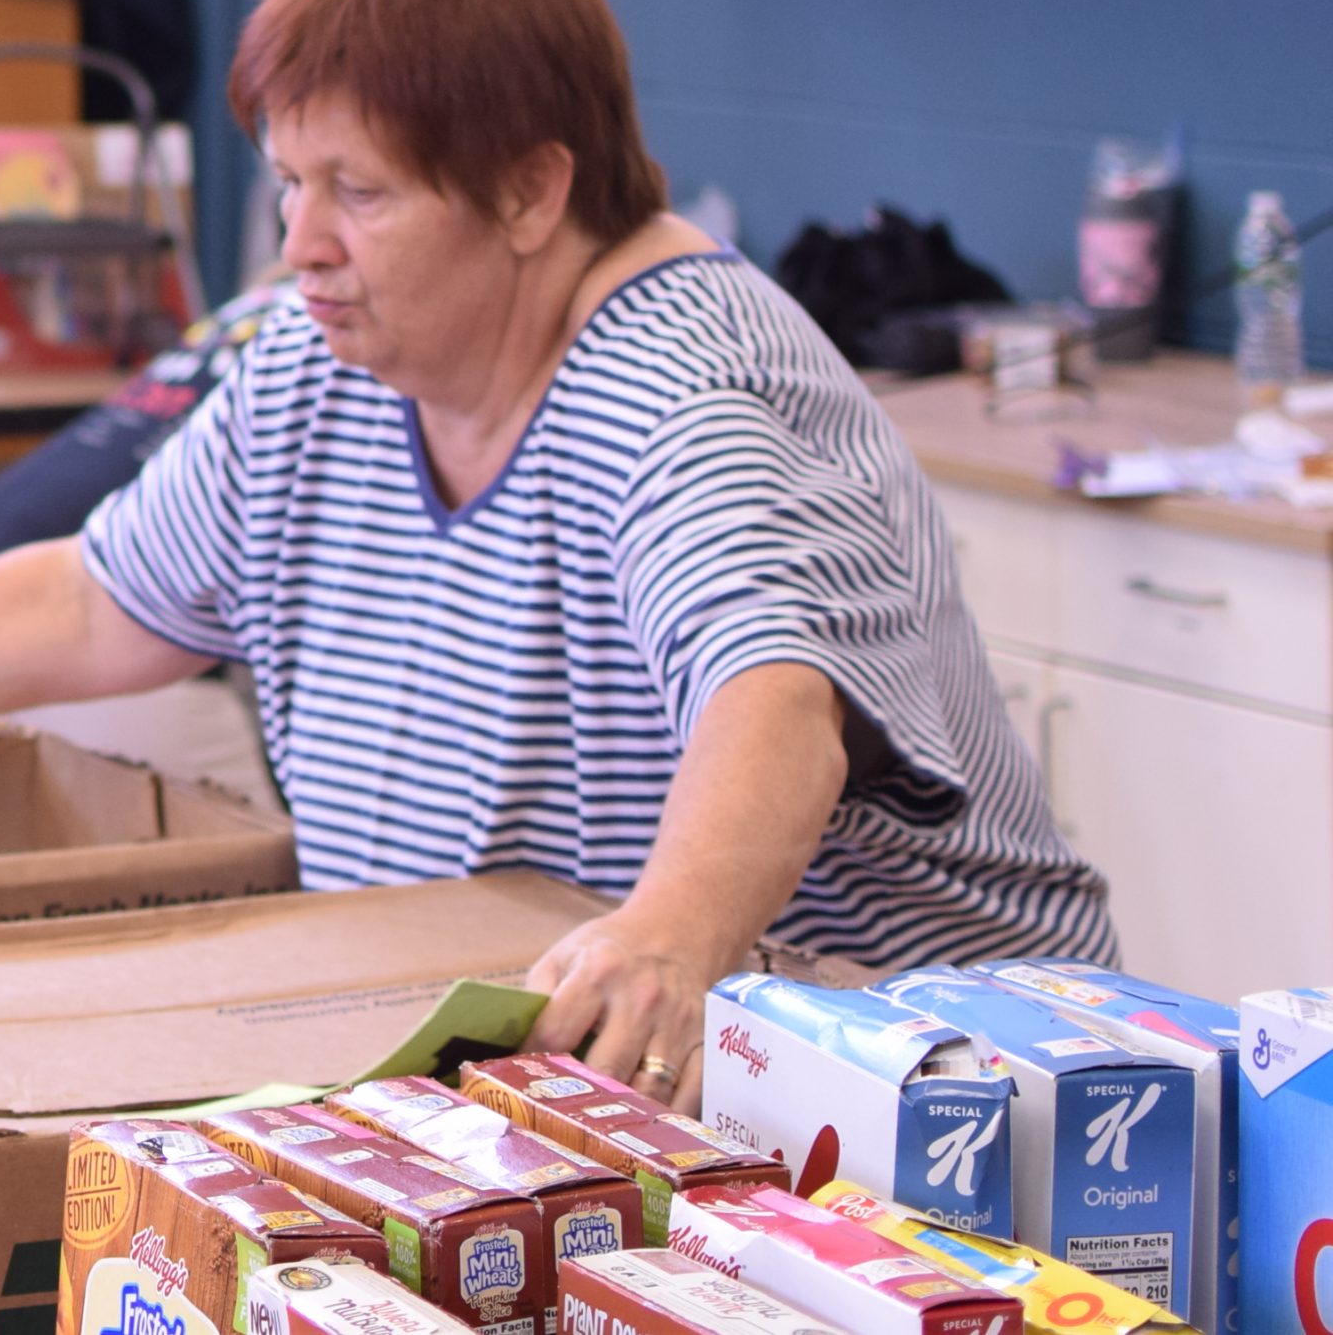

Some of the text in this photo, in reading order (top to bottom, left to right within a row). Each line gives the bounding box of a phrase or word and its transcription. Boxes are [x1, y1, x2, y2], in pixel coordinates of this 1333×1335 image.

[719, 1022, 771, 1078] Kellogg's
[1086, 1084, 1136, 1096] SPECIAL
[928, 1104, 983, 1118] SPECIAL
[716, 1112, 761, 1152] SPECIAL
[1085, 1082, 1162, 1172] K
[926, 1108, 1004, 1197] K
[66, 1151, 117, 1192] LIMITED
[830, 1194, 884, 1219] Post
[1084, 1184, 1159, 1211] Original
[66, 1194, 117, 1232] EDITION!
[570, 1216, 605, 1232] Frosted
[925, 1204, 993, 1233] Original
[475, 1237, 509, 1255] Frosted
[564, 1224, 614, 1254] Mini
[1070, 1237, 1169, 1251] Nutrition Facts
[132, 1228, 188, 1296] Kellogg's
[468, 1246, 517, 1277] Mini
[466, 1264, 519, 1294] Wheats
[1146, 1285, 1168, 1299] 210
[467, 1290, 517, 1308] Pumpkin
[480, 1303, 511, 1323] Spice
[500, 1320, 533, 1333] Facts
[943, 1318, 983, 1331] SPECIAL
